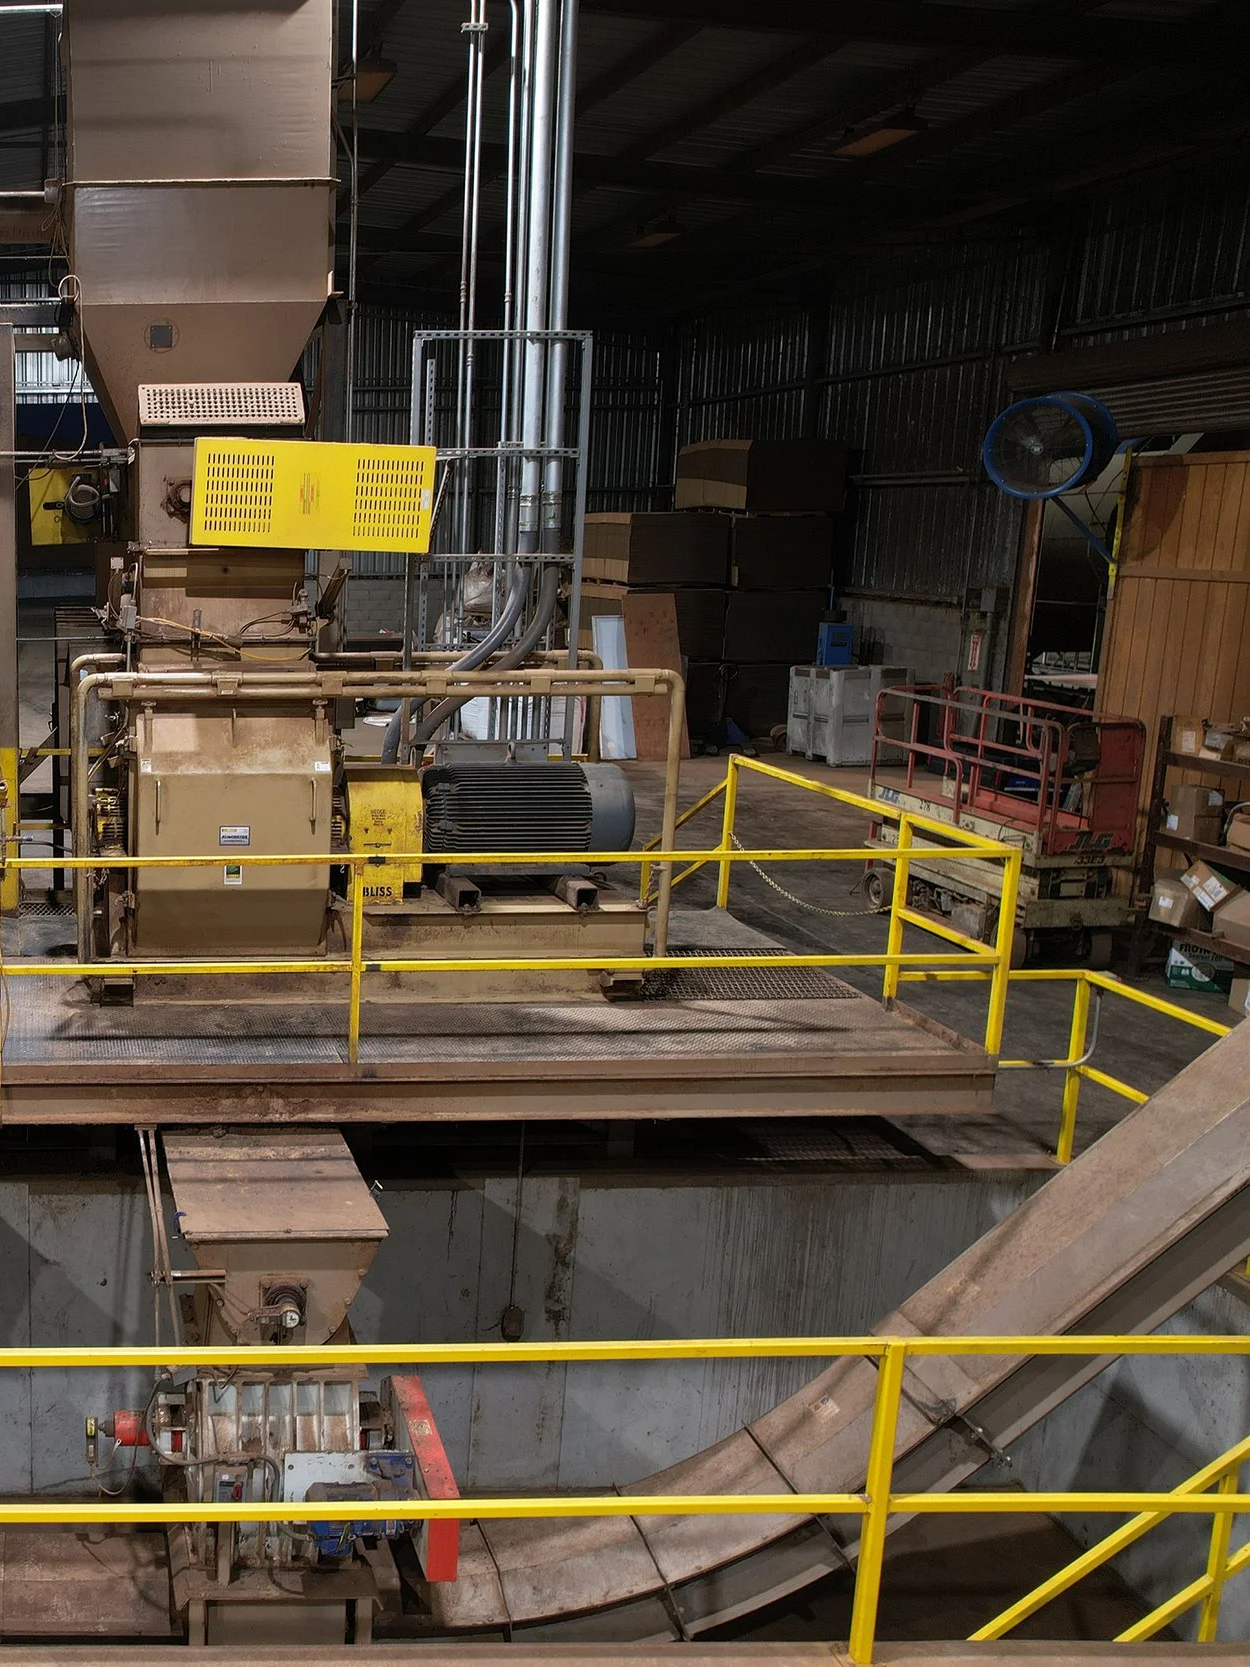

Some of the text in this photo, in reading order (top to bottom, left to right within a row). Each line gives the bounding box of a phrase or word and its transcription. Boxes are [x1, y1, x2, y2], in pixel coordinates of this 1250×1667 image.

[878, 788, 900, 804] JLG
[1070, 831, 1114, 850] JLG
[363, 886, 392, 897] BLISS
